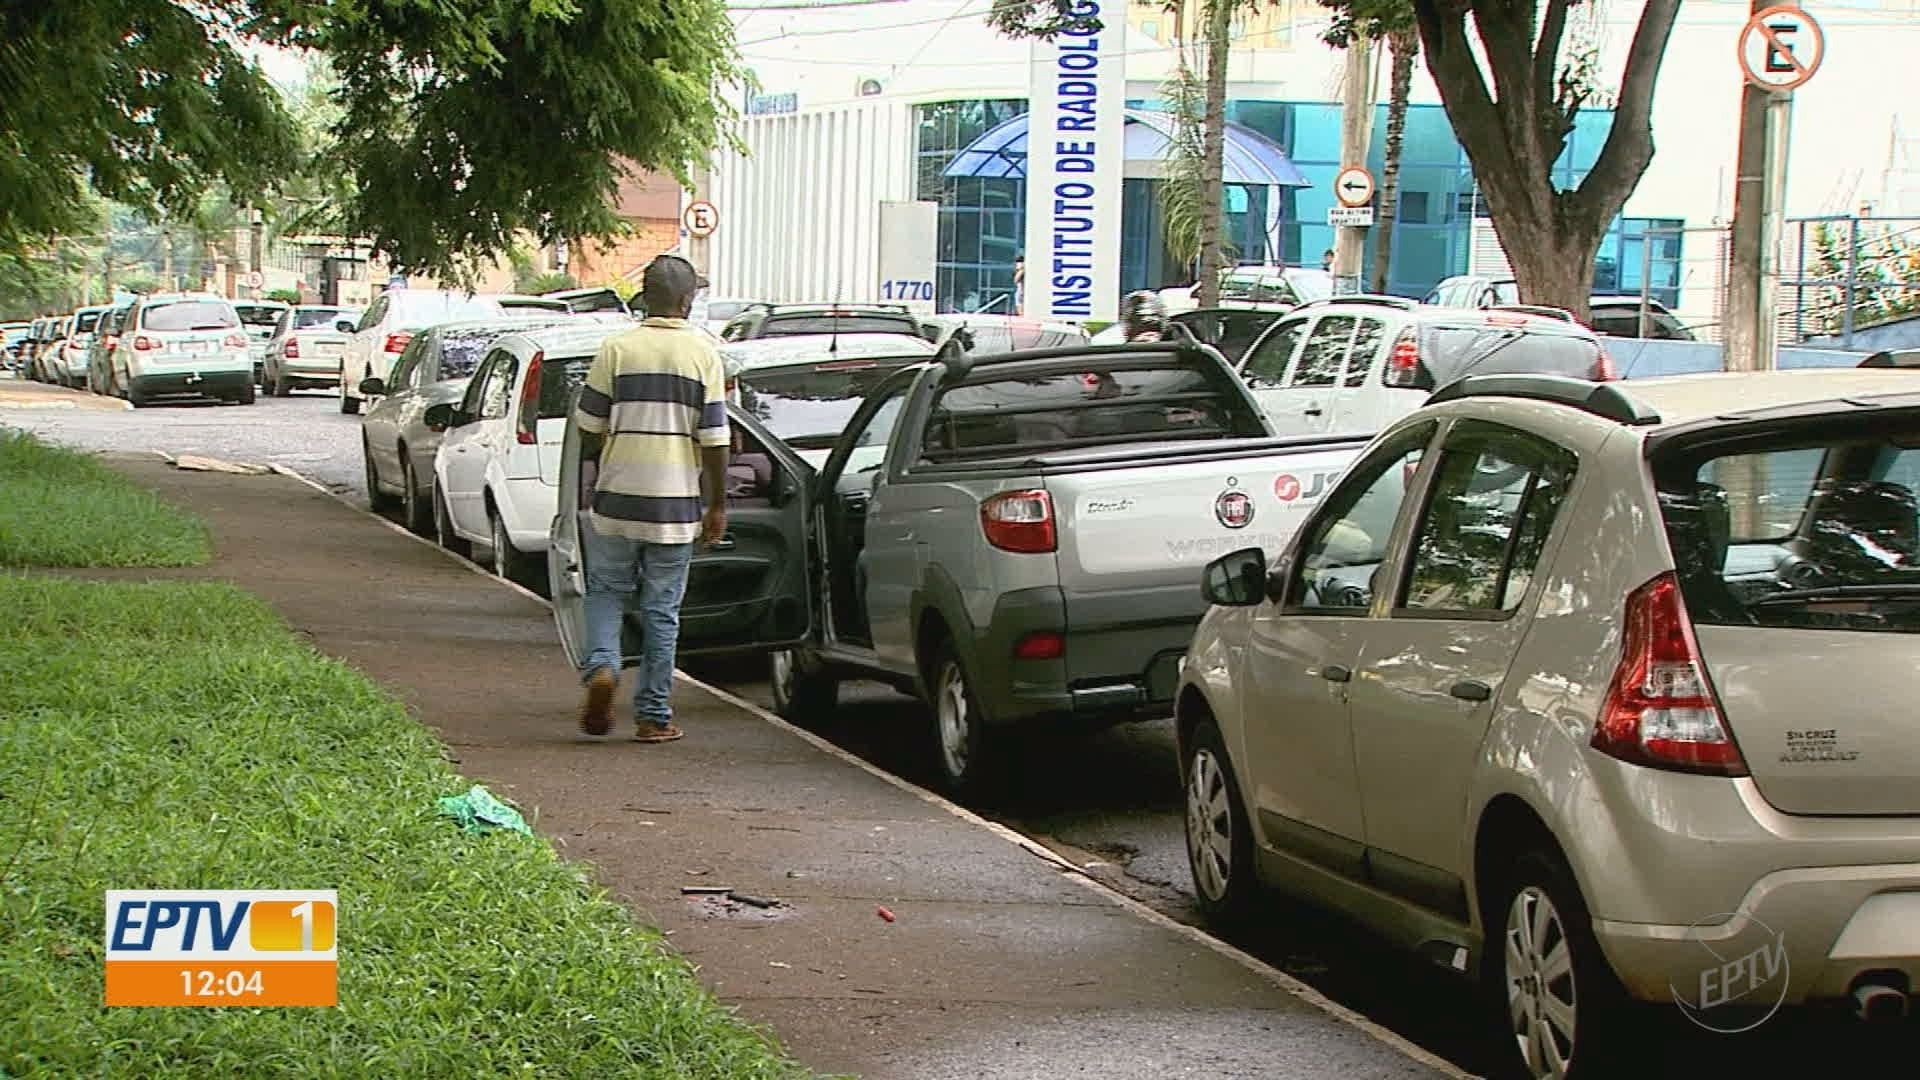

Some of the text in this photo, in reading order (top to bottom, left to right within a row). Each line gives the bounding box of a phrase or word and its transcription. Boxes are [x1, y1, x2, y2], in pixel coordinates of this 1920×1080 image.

[1055, 142, 1095, 173] DE
[1051, 182, 1095, 316] INSTITUTO
[883, 280, 933, 301] 1770
